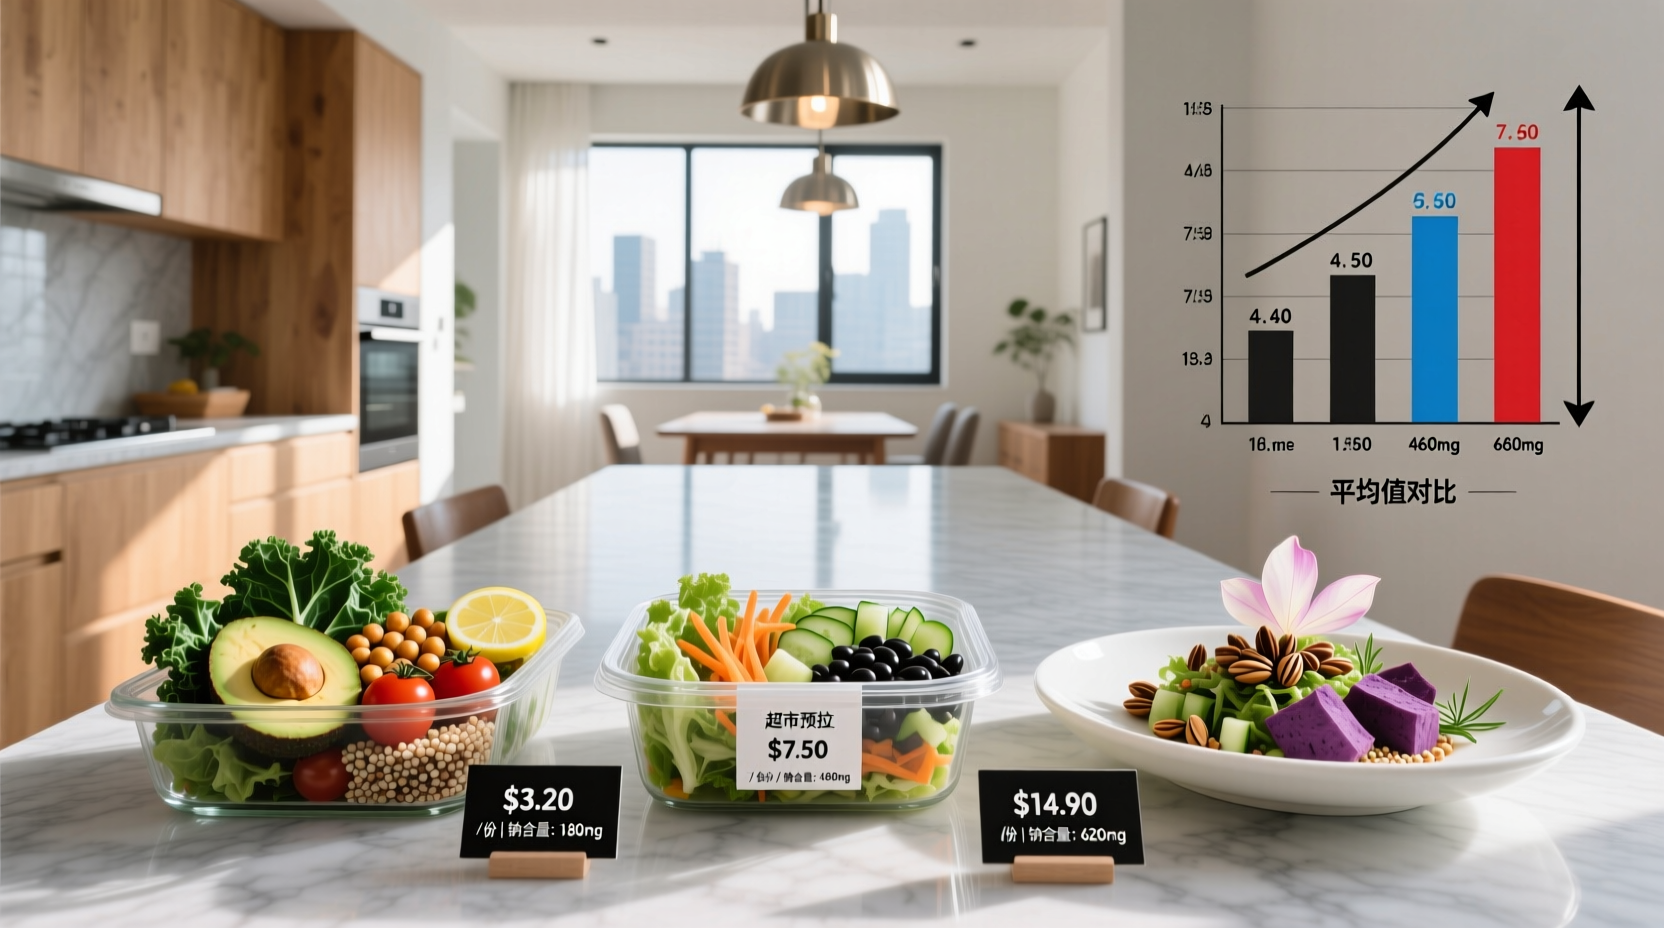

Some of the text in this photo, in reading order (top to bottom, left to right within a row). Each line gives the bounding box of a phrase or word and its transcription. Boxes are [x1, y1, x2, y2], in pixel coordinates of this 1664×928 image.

[768, 737, 828, 762] $7.50
[503, 784, 574, 815] $3.20
[1013, 788, 1098, 819] $14.90
